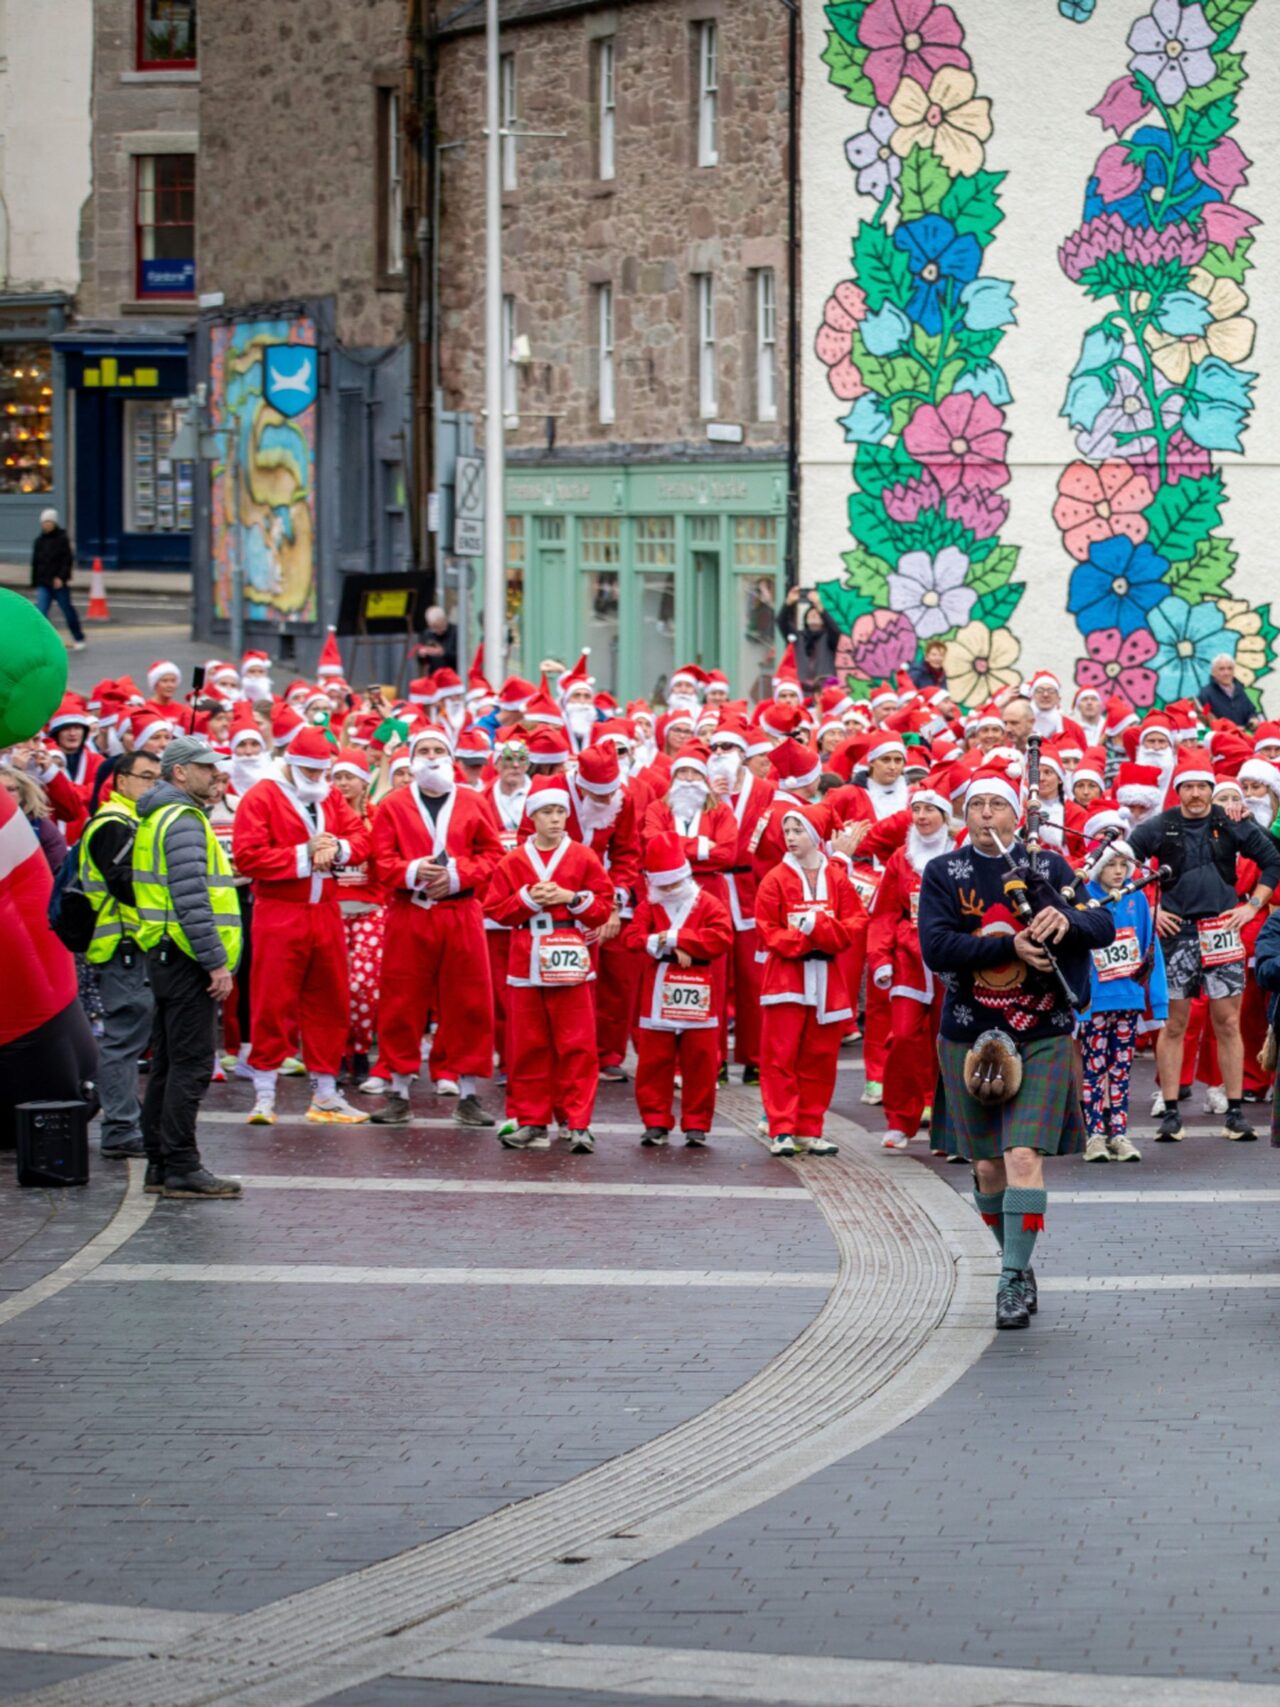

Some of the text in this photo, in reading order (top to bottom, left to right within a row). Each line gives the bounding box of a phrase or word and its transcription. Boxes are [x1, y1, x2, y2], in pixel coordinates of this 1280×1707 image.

[1213, 932, 1233, 949] 217
[551, 950, 579, 967] 072
[1103, 945, 1129, 965] 133
[673, 988, 700, 1005] 073
